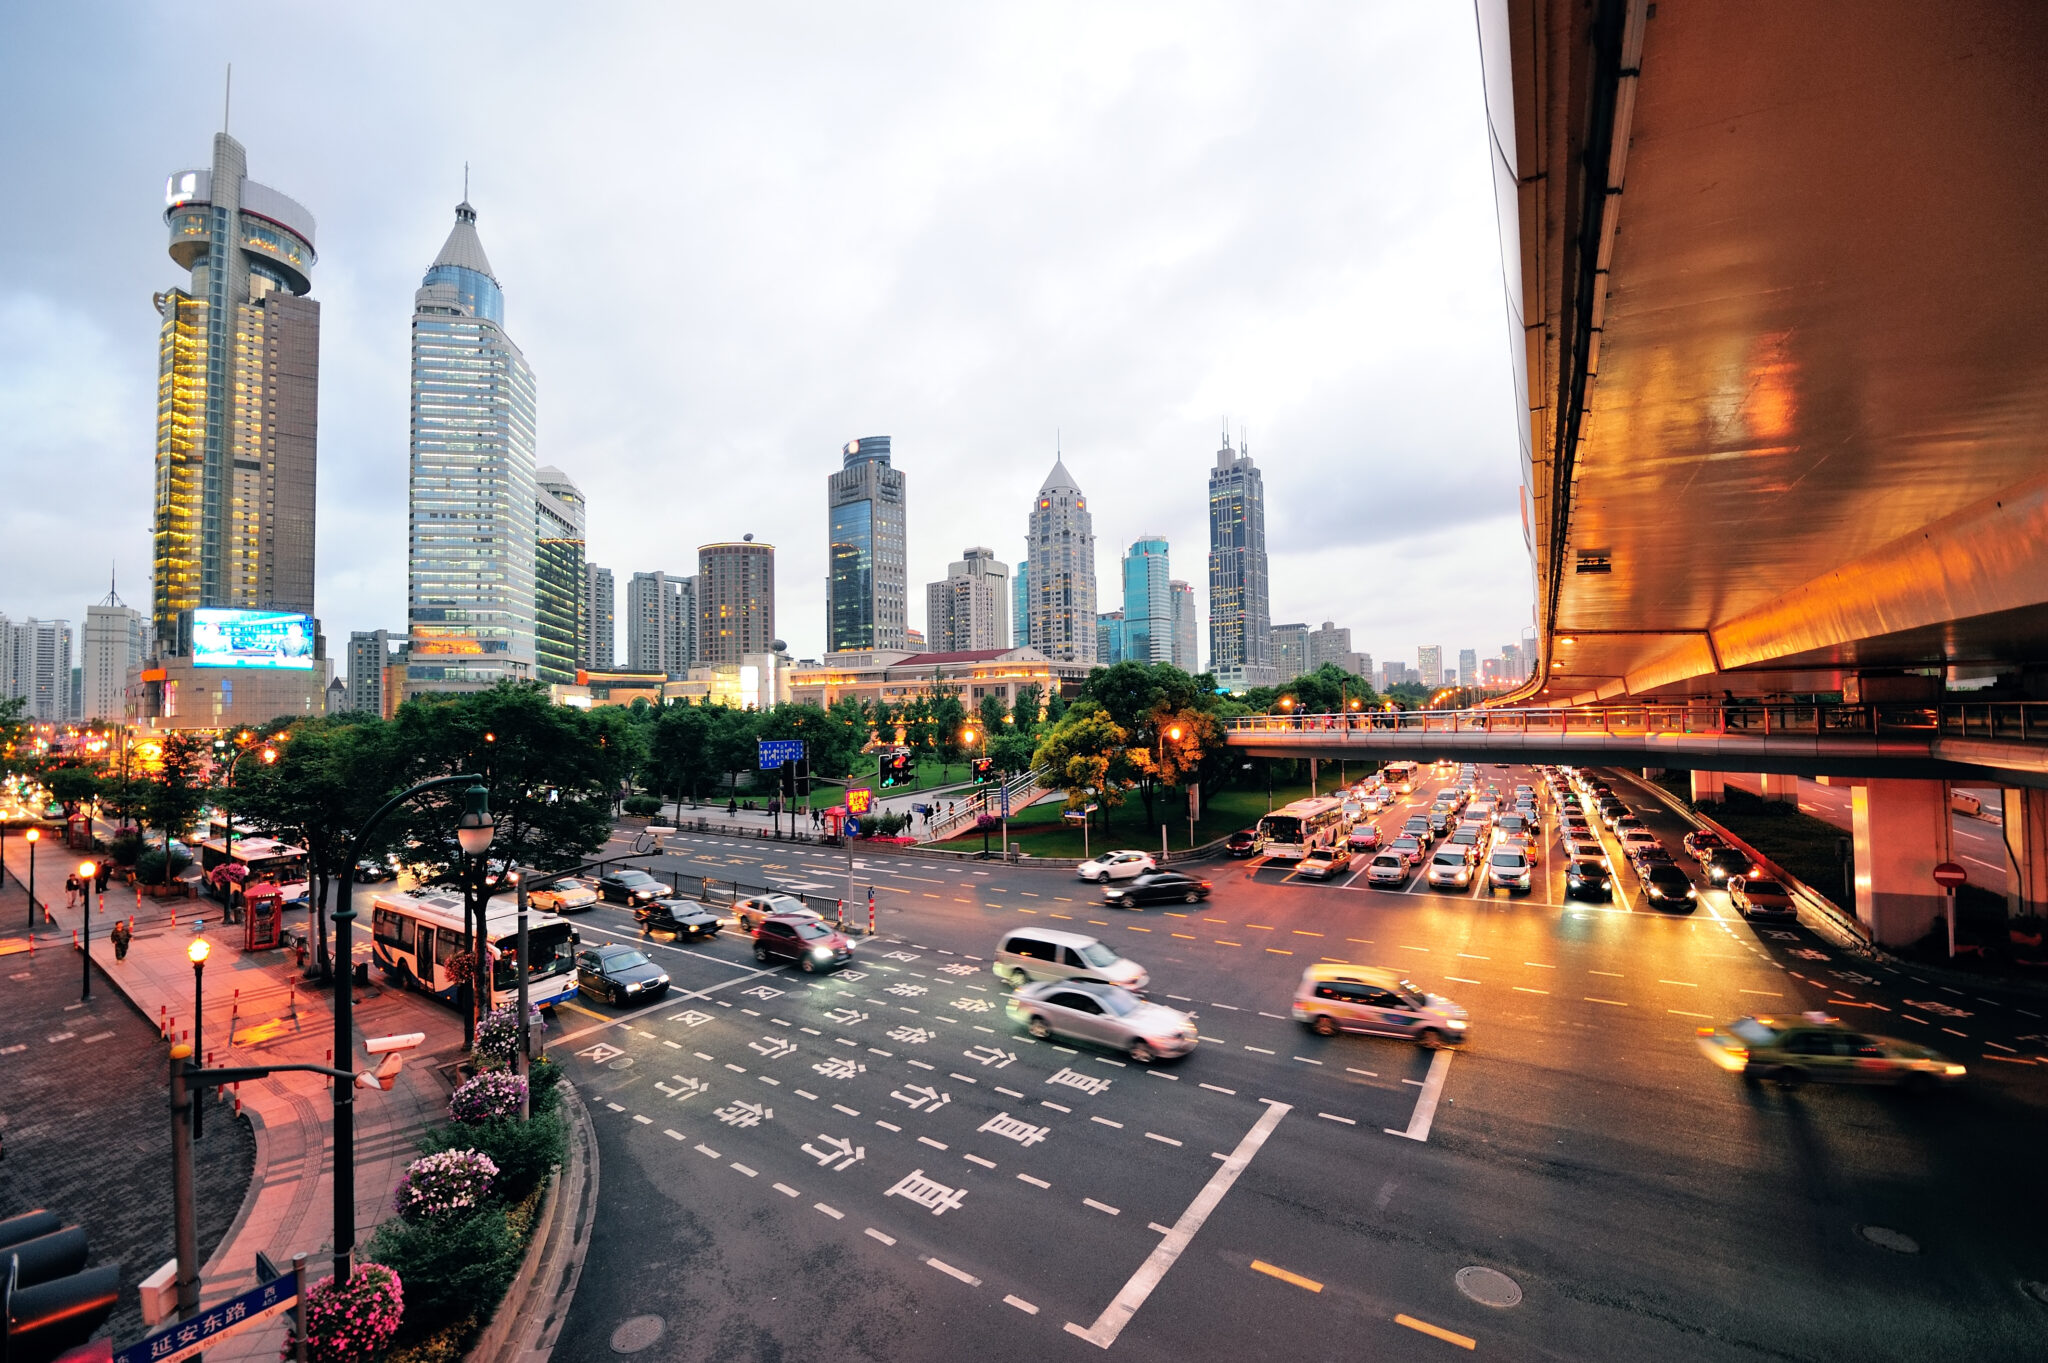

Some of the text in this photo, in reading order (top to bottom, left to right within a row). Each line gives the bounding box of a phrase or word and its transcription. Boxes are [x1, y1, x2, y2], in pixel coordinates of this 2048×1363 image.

[828, 968, 869, 982] 区
[881, 950, 921, 963] 区
[667, 1009, 1051, 1148] 直 行 待 行 区
[741, 985, 1113, 1096] 直 行 待 行 区
[574, 1042, 969, 1216] 直 行 待 行 区
[151, 1303, 247, 1359] 延安东路
